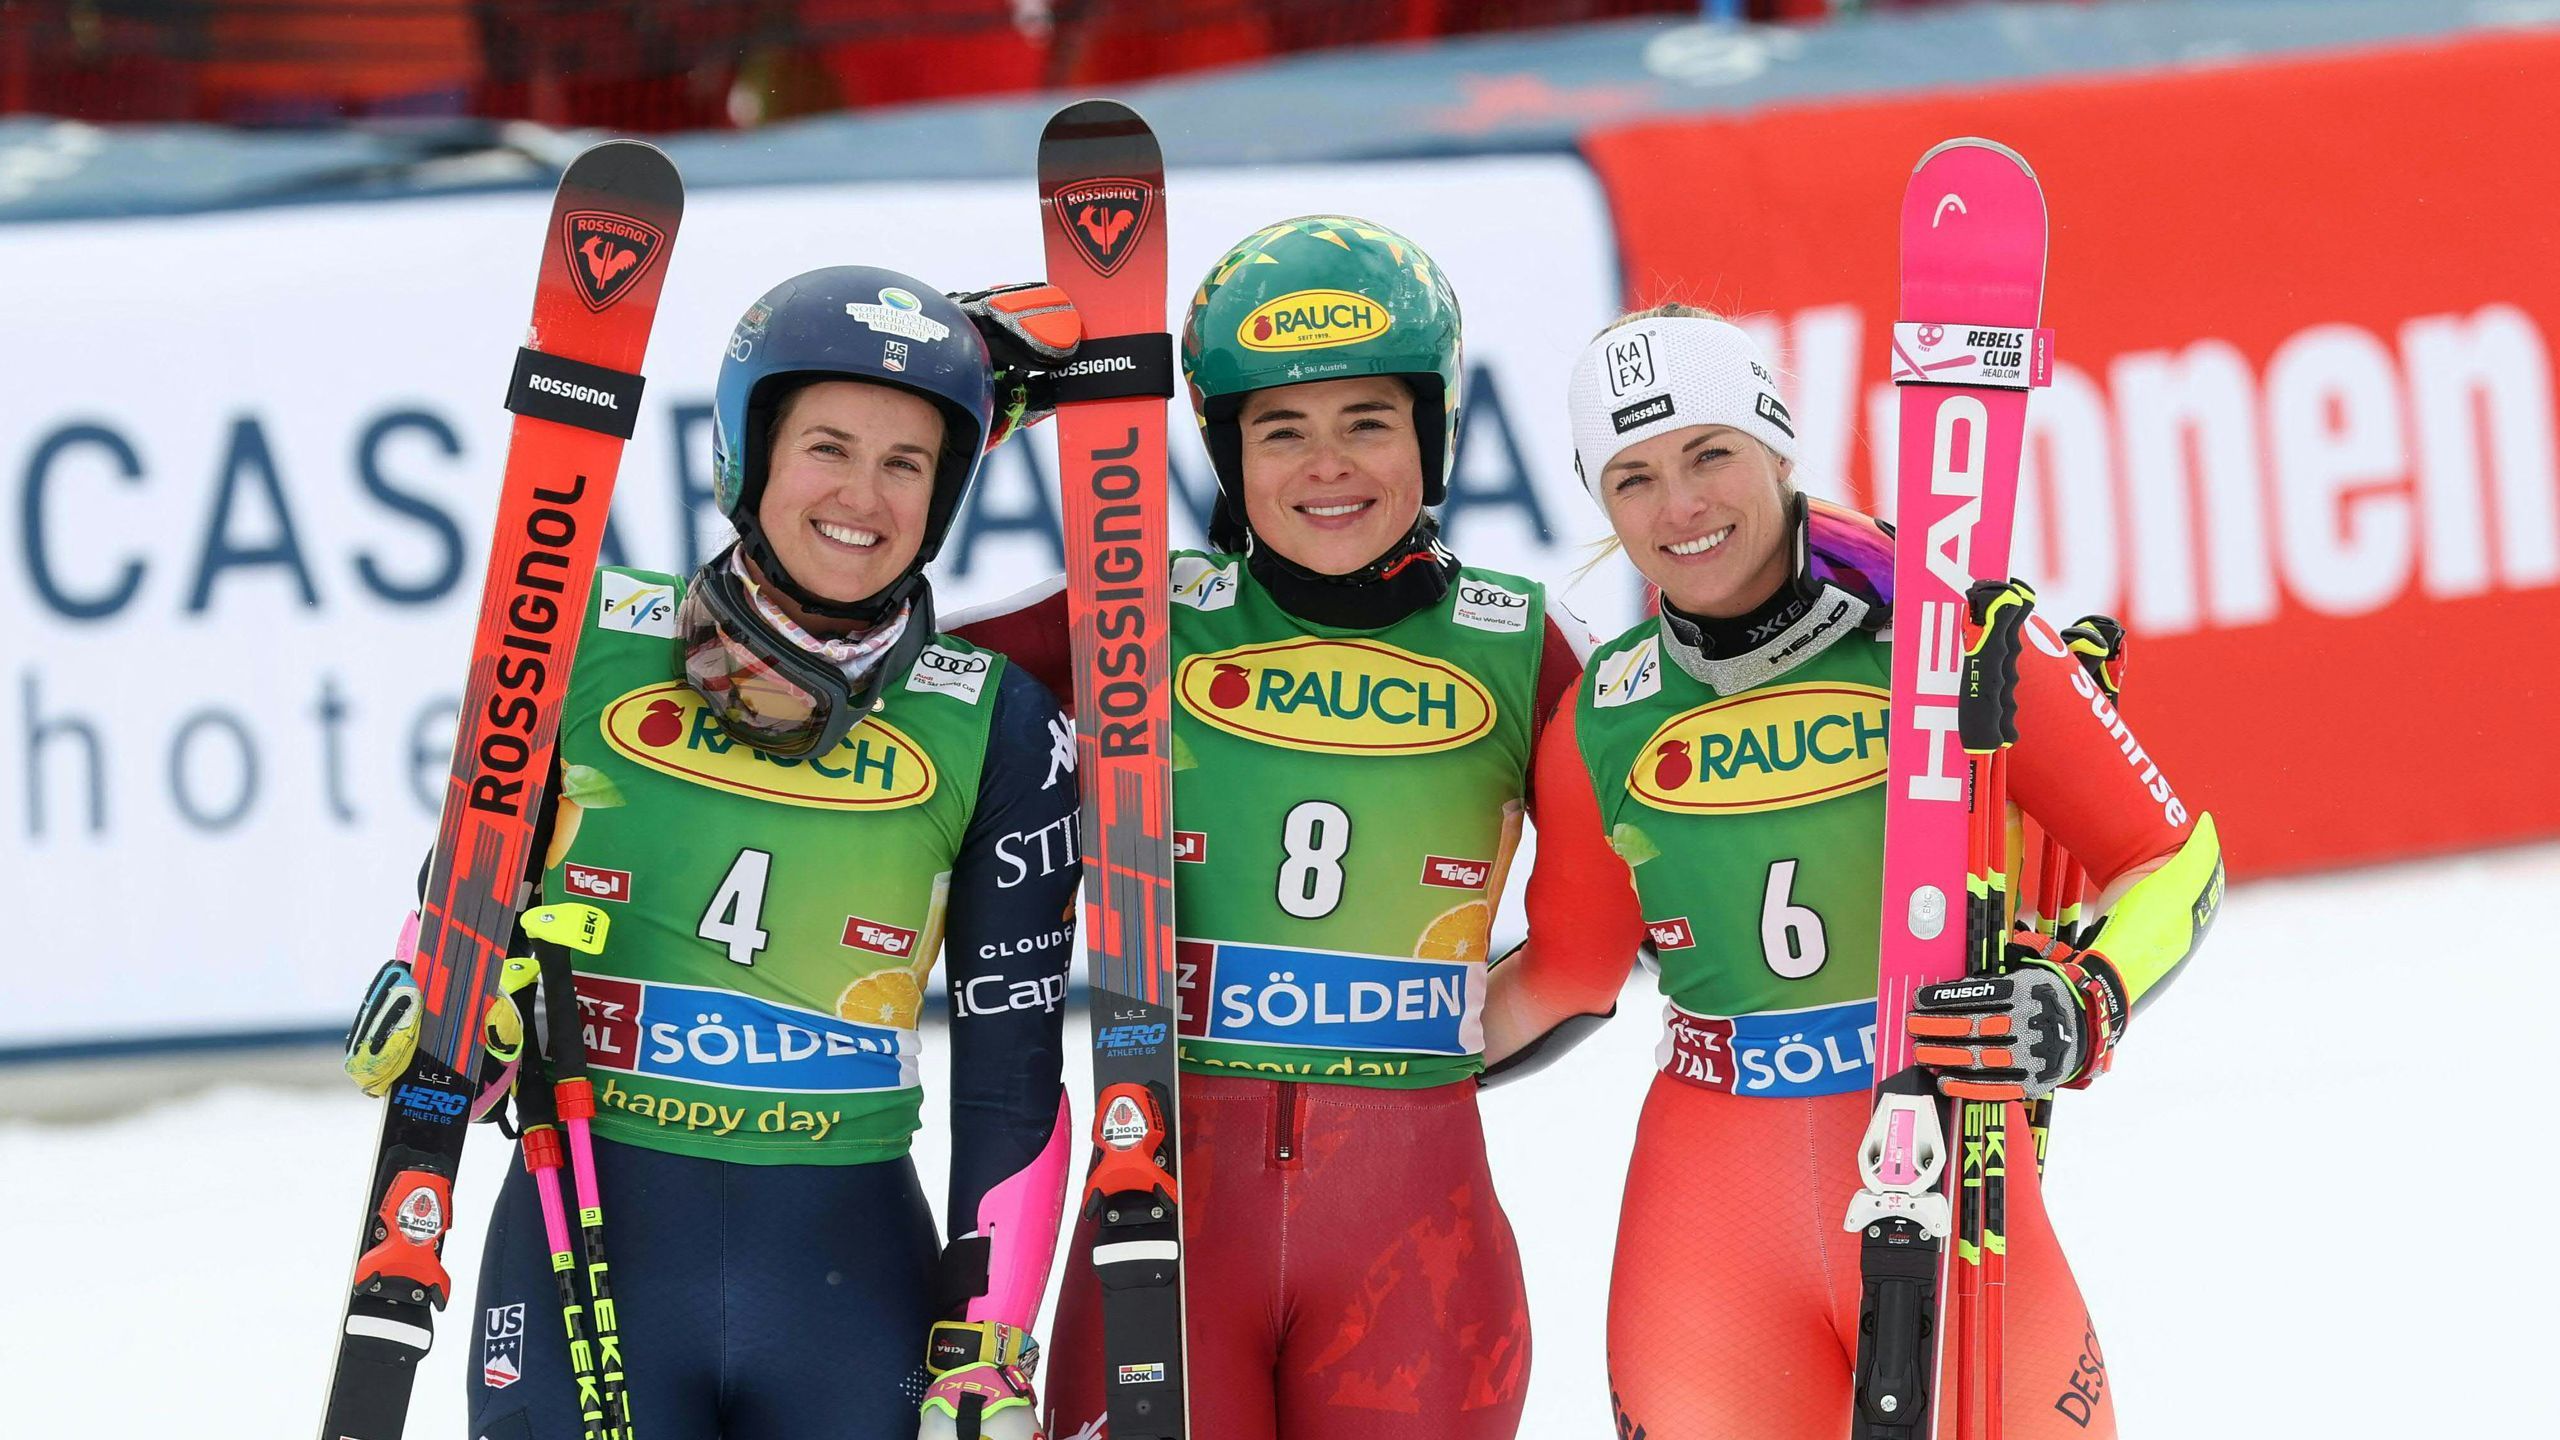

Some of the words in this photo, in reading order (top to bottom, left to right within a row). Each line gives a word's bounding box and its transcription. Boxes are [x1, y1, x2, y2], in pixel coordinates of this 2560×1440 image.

[577, 218, 649, 247] ROSSIGNOL
[872, 320, 927, 340] MEDICINE
[1274, 304, 1372, 335] RAUCH
[886, 341, 906, 355] US
[1615, 341, 1641, 366] KA
[1966, 330, 2024, 349] REBELS
[1304, 365, 1317, 374] Ski
[1319, 362, 1348, 372] Austria
[1983, 350, 2022, 368] CLUB
[2037, 337, 2045, 381] HEAD
[1619, 362, 1646, 389] EX
[528, 373, 619, 411] ROSSIGNOL
[1617, 400, 1668, 428] swissski
[1091, 427, 1150, 759] ROSSIGNOL
[1908, 395, 1988, 802] HEAD
[1459, 608, 1477, 616] Audi
[1483, 616, 1506, 625] World
[469, 474, 587, 817] ROSSIGNOL
[1769, 600, 1850, 664] HEAD
[915, 673, 934, 681] Audi
[962, 683, 976, 693] Cup
[1970, 658, 1980, 698] LEKI
[1255, 668, 1456, 729] RAUCH
[1700, 708, 1890, 783] RAUCH
[1275, 800, 1353, 921] 8
[1435, 862, 1486, 886] Tirol
[569, 870, 620, 895] Tirol
[697, 847, 774, 967] 4
[1759, 857, 1830, 981] 6
[581, 911, 599, 945] LEKI
[855, 925, 909, 952] Tirol
[1221, 971, 1461, 1028] SÖLDEN
[1933, 982, 1996, 1000] reusch
[1096, 1023, 1167, 1049] HERO
[1107, 1048, 1143, 1058] ATHLETE
[1145, 1046, 1157, 1055] GS
[1675, 1048, 1723, 1084] TAL
[394, 1083, 468, 1116] HERO
[602, 1078, 747, 1137] happy
[758, 1101, 841, 1142] day
[402, 1108, 439, 1123] ATHLETE
[440, 1115, 452, 1125] GS
[1115, 1126, 1144, 1134] LOOK
[1888, 1114, 1899, 1163] HEAD
[411, 1217, 439, 1229] LOOK
[486, 1305, 523, 1338] US
[589, 1262, 625, 1383] LEKI
[563, 1304, 604, 1422] LEKI
[940, 1381, 1001, 1398] LEKI
[1120, 1372, 1151, 1383] LOOK
